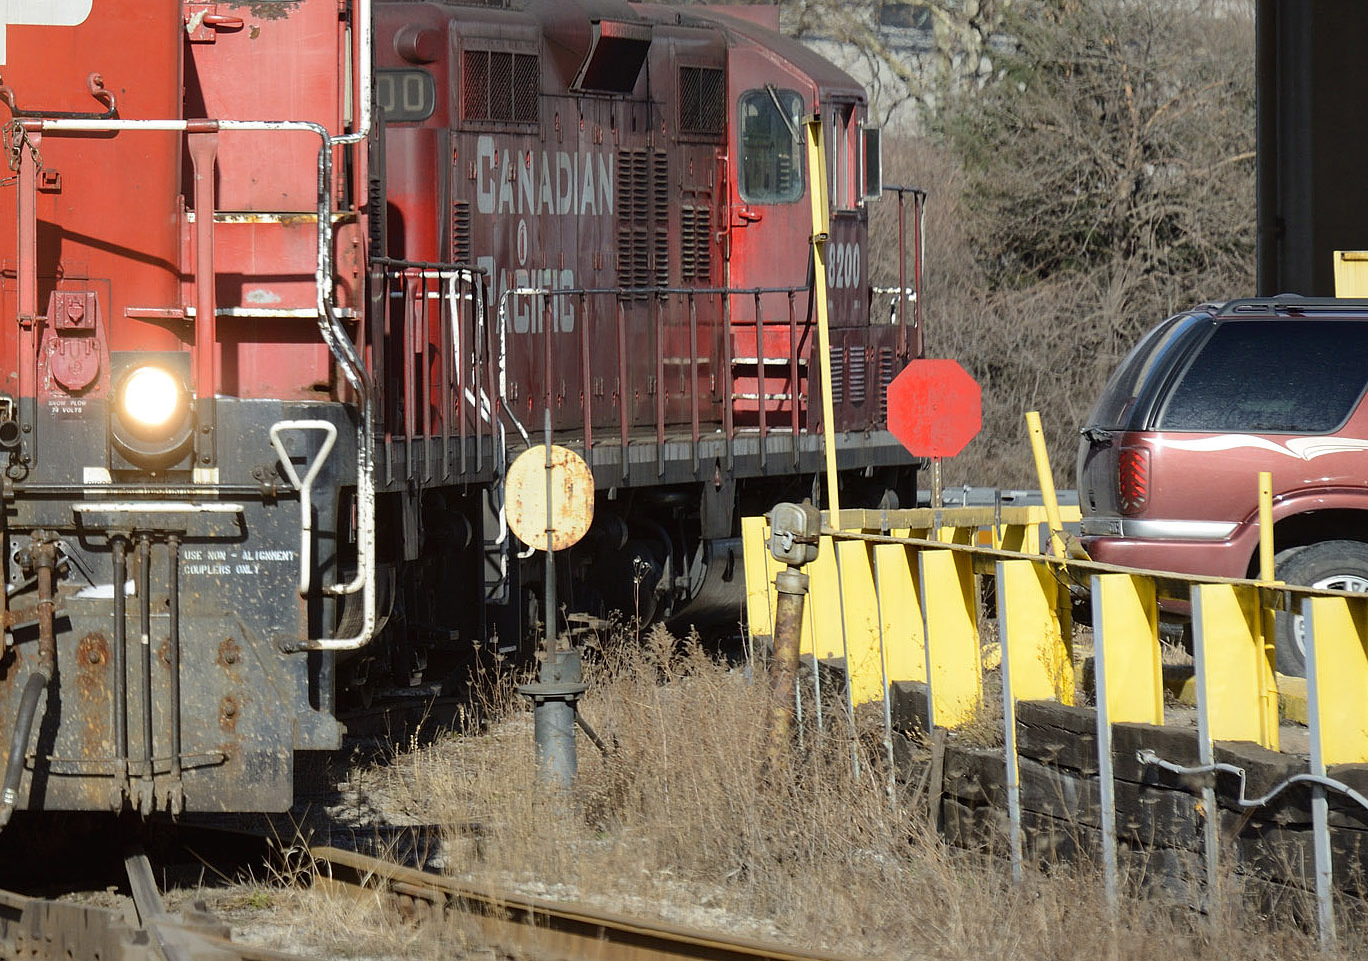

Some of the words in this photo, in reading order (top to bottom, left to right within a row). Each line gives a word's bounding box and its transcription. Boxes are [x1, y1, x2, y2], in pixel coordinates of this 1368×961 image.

[476, 135, 615, 216] CANADIAN
[828, 242, 861, 289] 8200
[183, 564, 232, 575] COUPLERS
[235, 564, 260, 575] ONLY
[184, 550, 203, 560] USE
[207, 550, 227, 560] NON
[241, 550, 294, 561] ALIGNMENT
